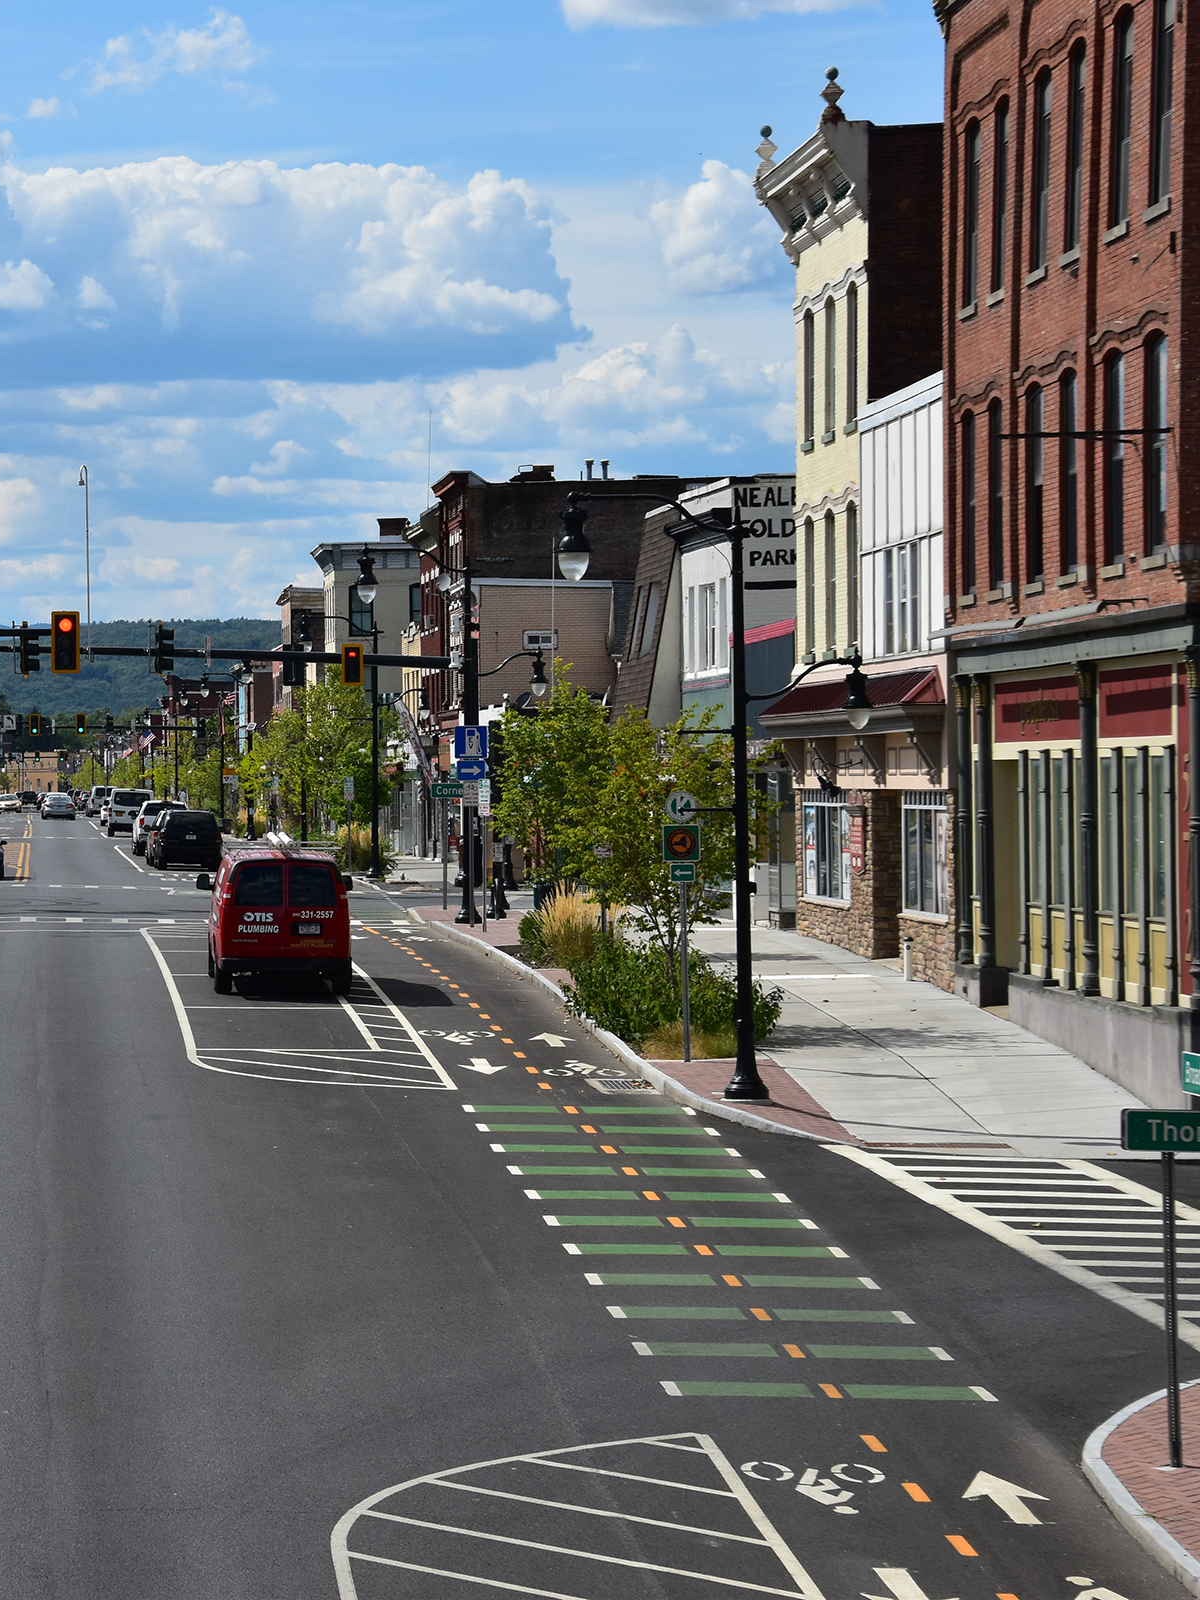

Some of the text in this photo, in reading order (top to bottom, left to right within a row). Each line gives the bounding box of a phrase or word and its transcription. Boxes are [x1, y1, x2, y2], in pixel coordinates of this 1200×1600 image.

[243, 912, 274, 922] OTIS
[300, 910, 334, 919] 331-2557
[237, 924, 279, 933] PLUMBING
